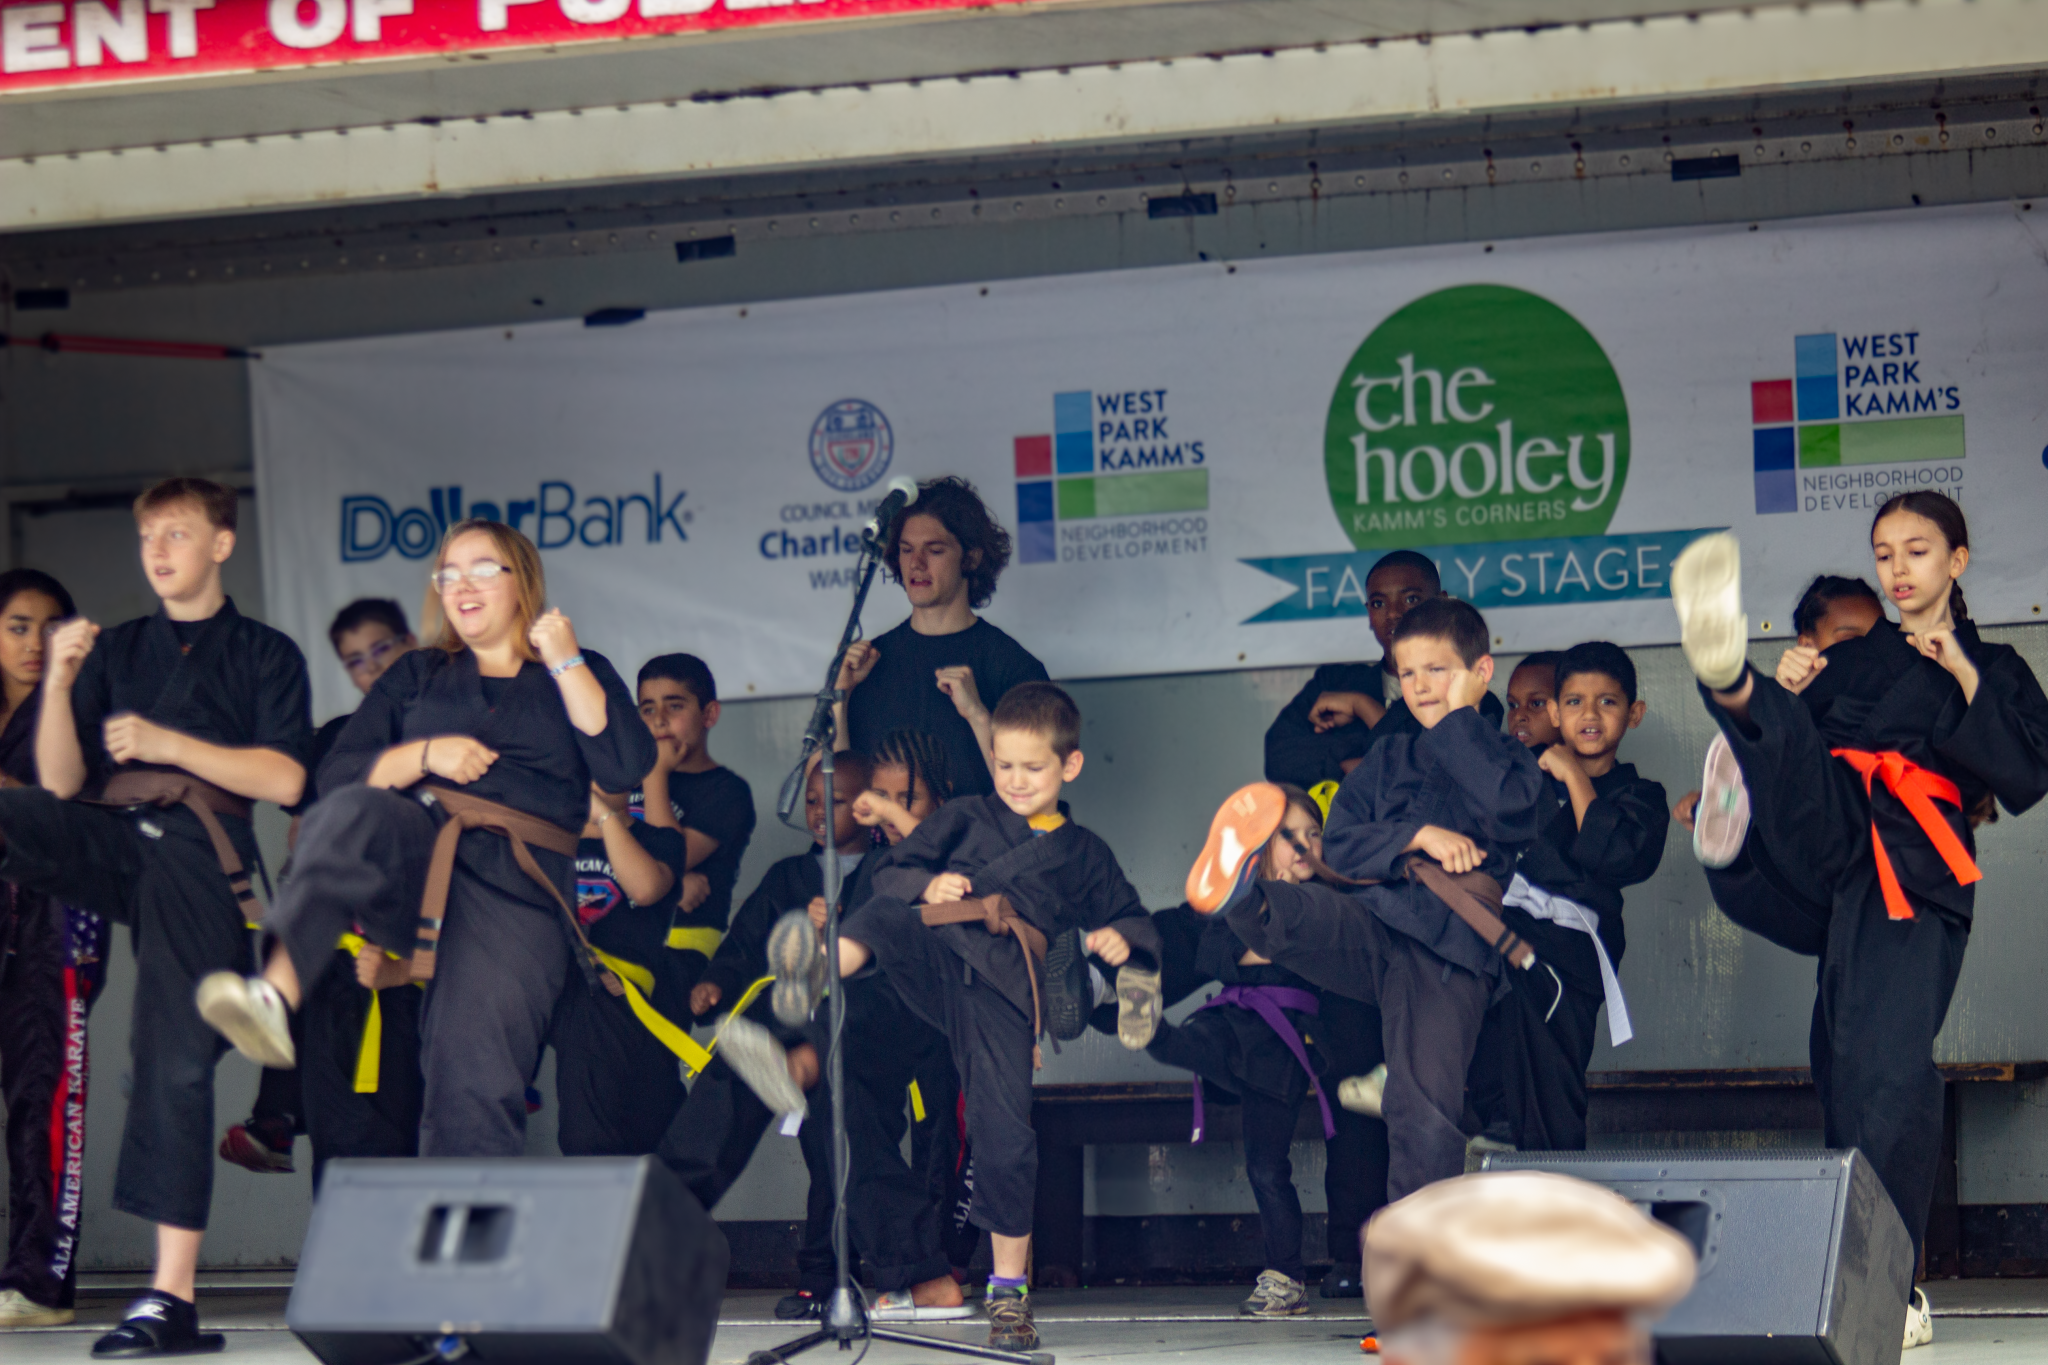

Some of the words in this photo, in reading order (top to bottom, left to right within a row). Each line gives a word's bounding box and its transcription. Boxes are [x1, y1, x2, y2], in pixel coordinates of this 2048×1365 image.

[1843, 332, 1919, 360] WEST
[1845, 360, 1920, 388] PARK
[1097, 389, 1168, 416] WEST
[1350, 353, 1496, 431] the
[1846, 386, 1961, 417] KAMM'S
[1099, 417, 1168, 443] PARK
[1100, 441, 1206, 471] KAMM'S
[1349, 419, 1616, 512] hooley
[1803, 466, 1963, 491] NEIGHBORHOOD
[780, 500, 853, 523] COUNCIL
[1353, 508, 1447, 533] KAMM'S
[1455, 500, 1567, 527] CORNERS
[759, 525, 861, 560] Charle
[1061, 517, 1209, 543] NEIGHBORHOOD
[1061, 536, 1209, 562] DEVELOPMENT
[809, 567, 858, 590] WAR
[1501, 545, 1663, 598] STAGE
[65, 997, 87, 1096] KARATE
[60, 1102, 84, 1231] AMERICAN
[49, 1235, 73, 1280] ALL
